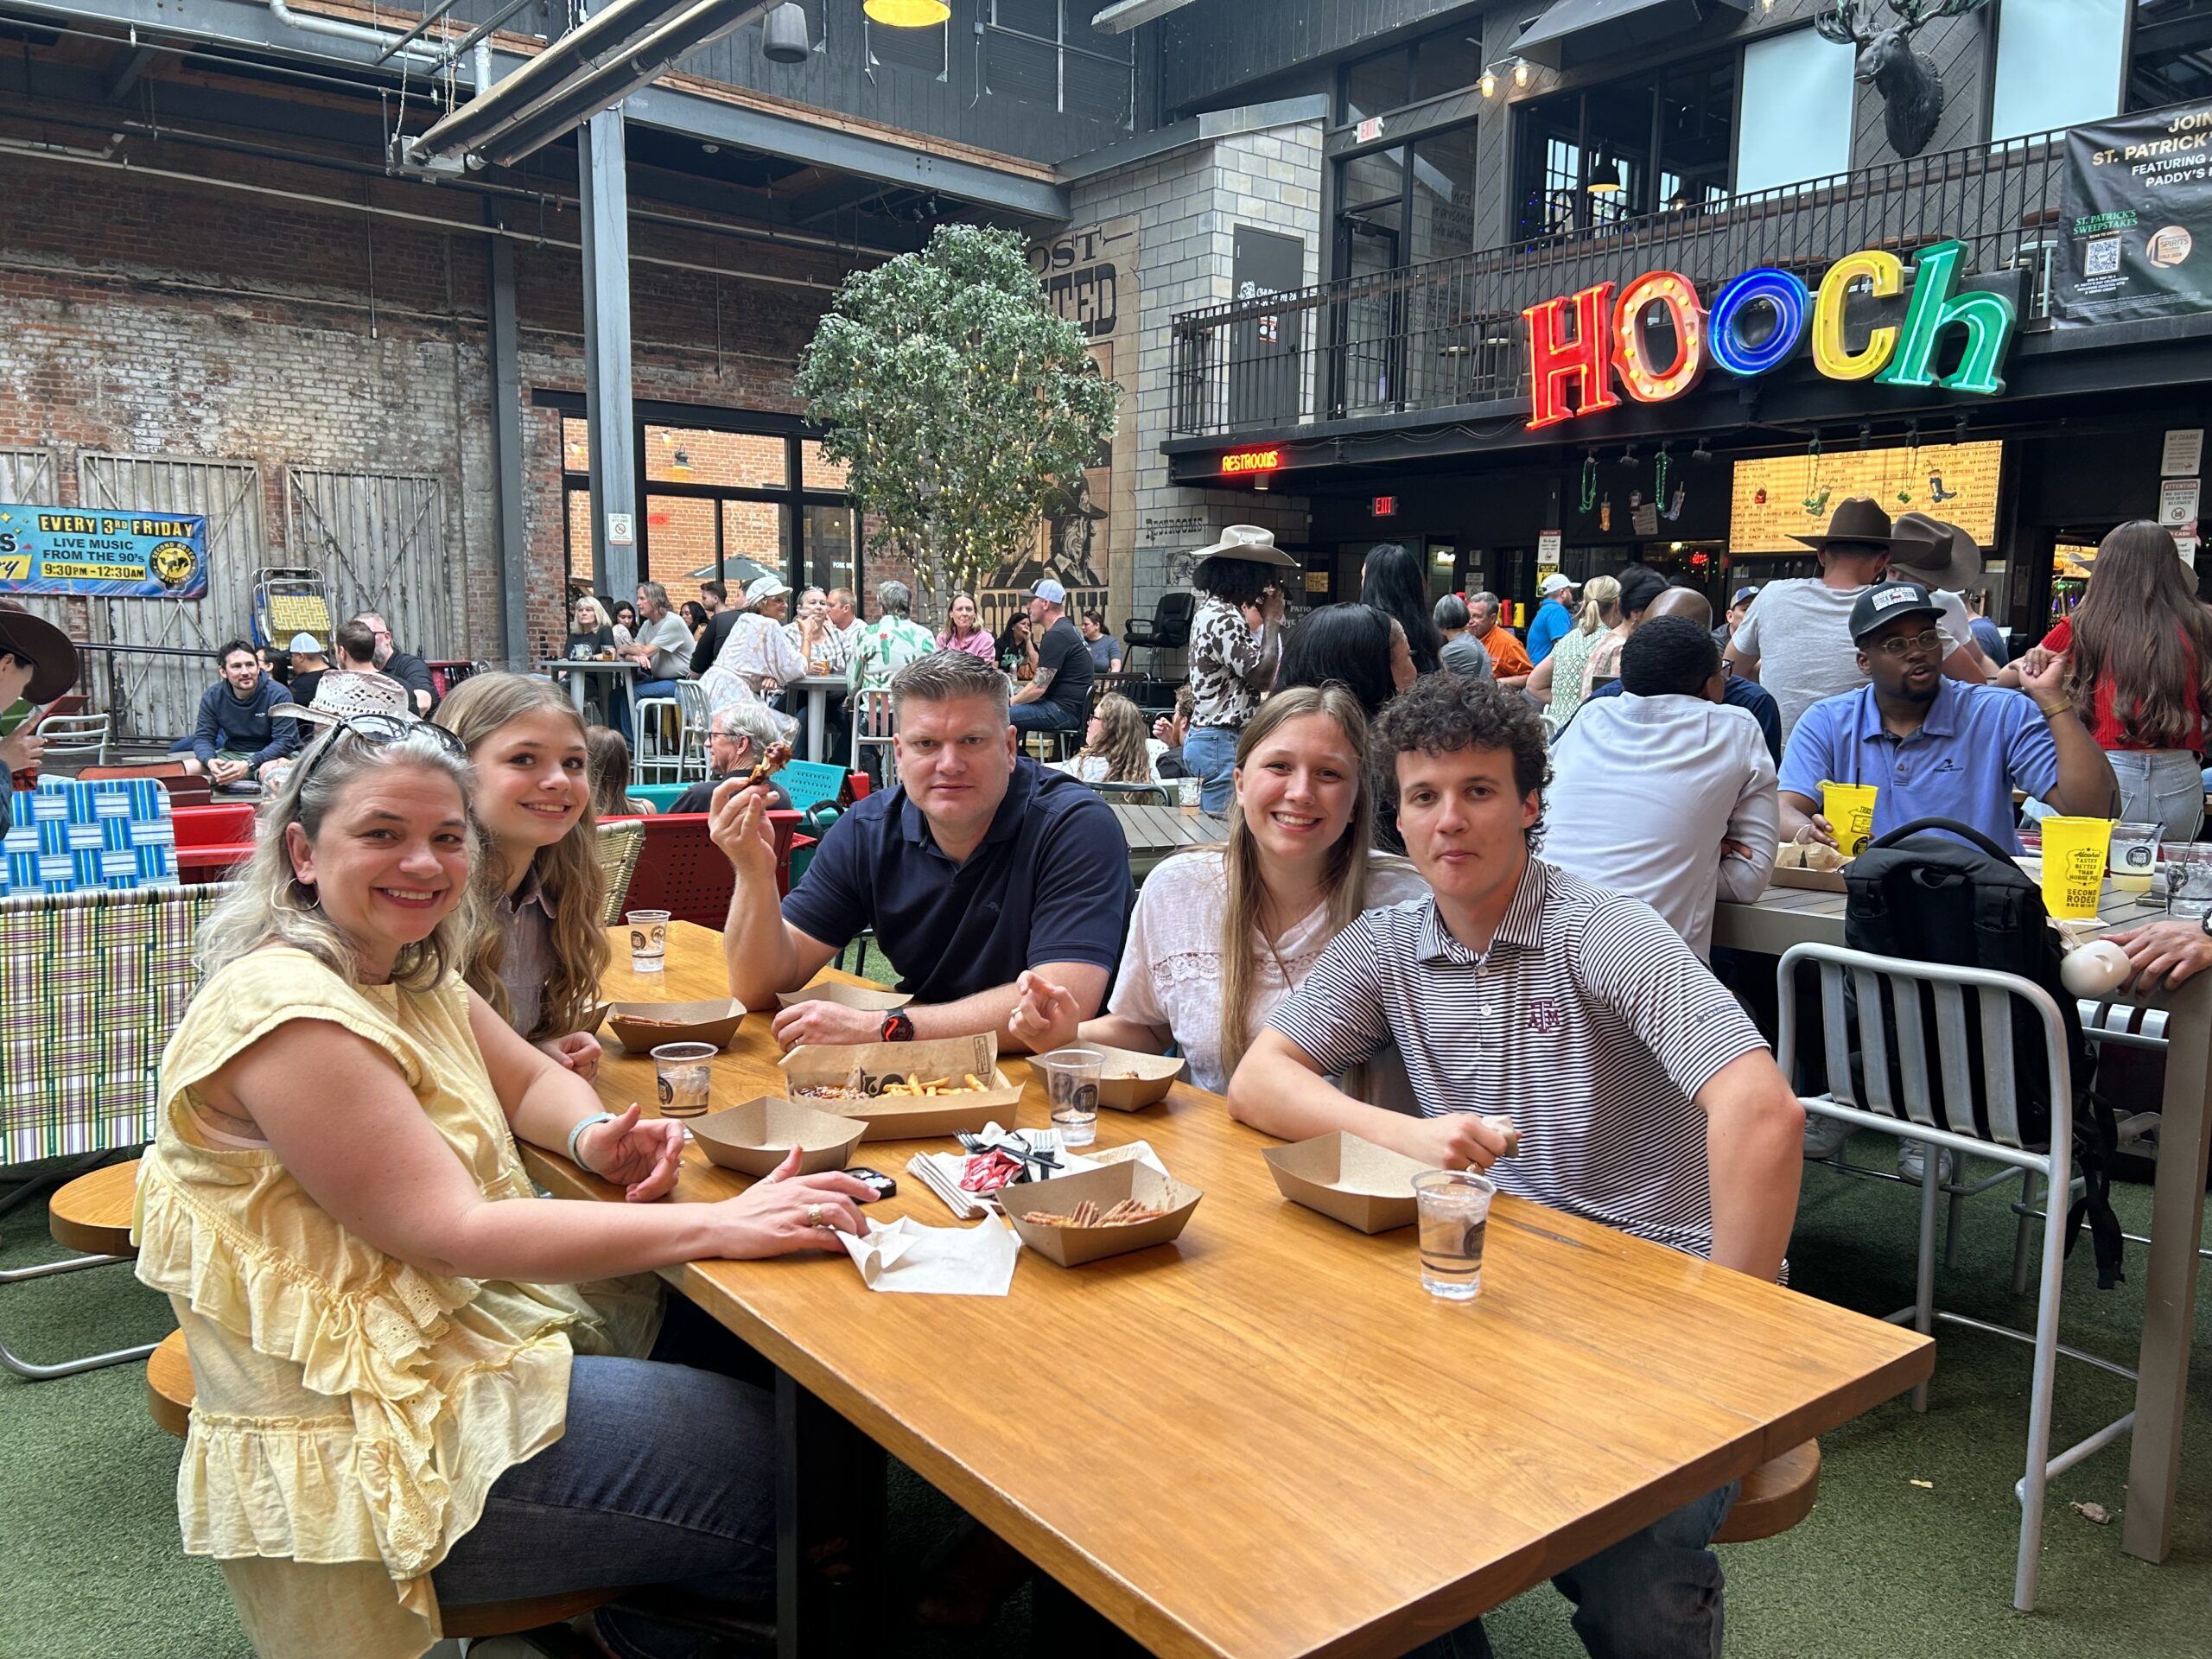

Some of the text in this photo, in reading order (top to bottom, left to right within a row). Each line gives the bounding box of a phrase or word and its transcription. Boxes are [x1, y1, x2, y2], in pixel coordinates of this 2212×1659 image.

[1360, 118, 1376, 140] EXIT
[2093, 149, 2119, 166] ST.
[2132, 154, 2205, 176] FEATURING
[2145, 168, 2205, 188] PADDY'S
[2075, 209, 2136, 226] ST. PATRICK'S
[2074, 218, 2138, 235] SWEEPSTAKES
[1027, 226, 1103, 275] OST
[2161, 238, 2189, 247] SPIRITS
[1223, 451, 1279, 473] RESTROOMS
[2165, 482, 2196, 491] ATTENTION
[1376, 496, 1393, 515] EXIT
[40, 515, 194, 537] EVERY 3RD FRIDAY
[1146, 518, 1203, 540] RESTROOMS
[54, 537, 133, 550] LIVE MUSIC
[152, 543, 175, 559] SECOND
[43, 550, 145, 563] FROM THE 90's
[45, 563, 87, 576] 9:30PM
